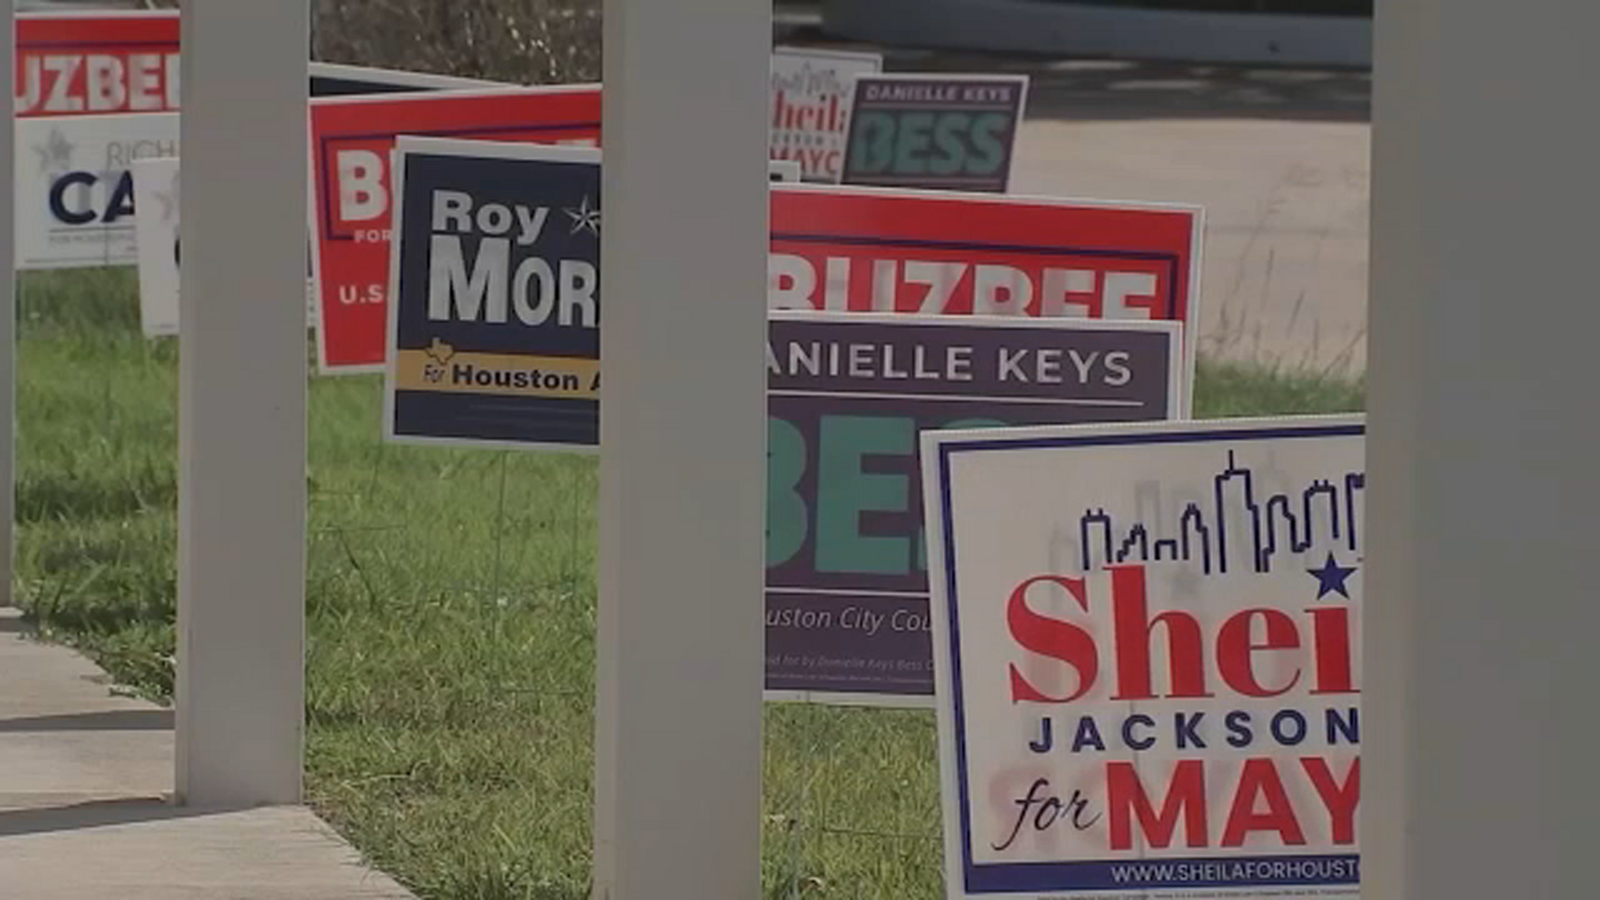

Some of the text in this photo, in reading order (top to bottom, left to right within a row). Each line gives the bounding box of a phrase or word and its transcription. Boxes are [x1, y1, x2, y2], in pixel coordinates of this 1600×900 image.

[866, 85, 1011, 101] DANIELLE KEYS
[851, 112, 1012, 173] BESS
[432, 190, 549, 245] Roy
[452, 364, 579, 390] Houston
[1000, 350, 1132, 386] KEYS
[840, 607, 883, 635] City
[1006, 564, 1361, 704] Shei
[1029, 708, 1360, 753] JACKSON
[991, 757, 1361, 851] for MAY
